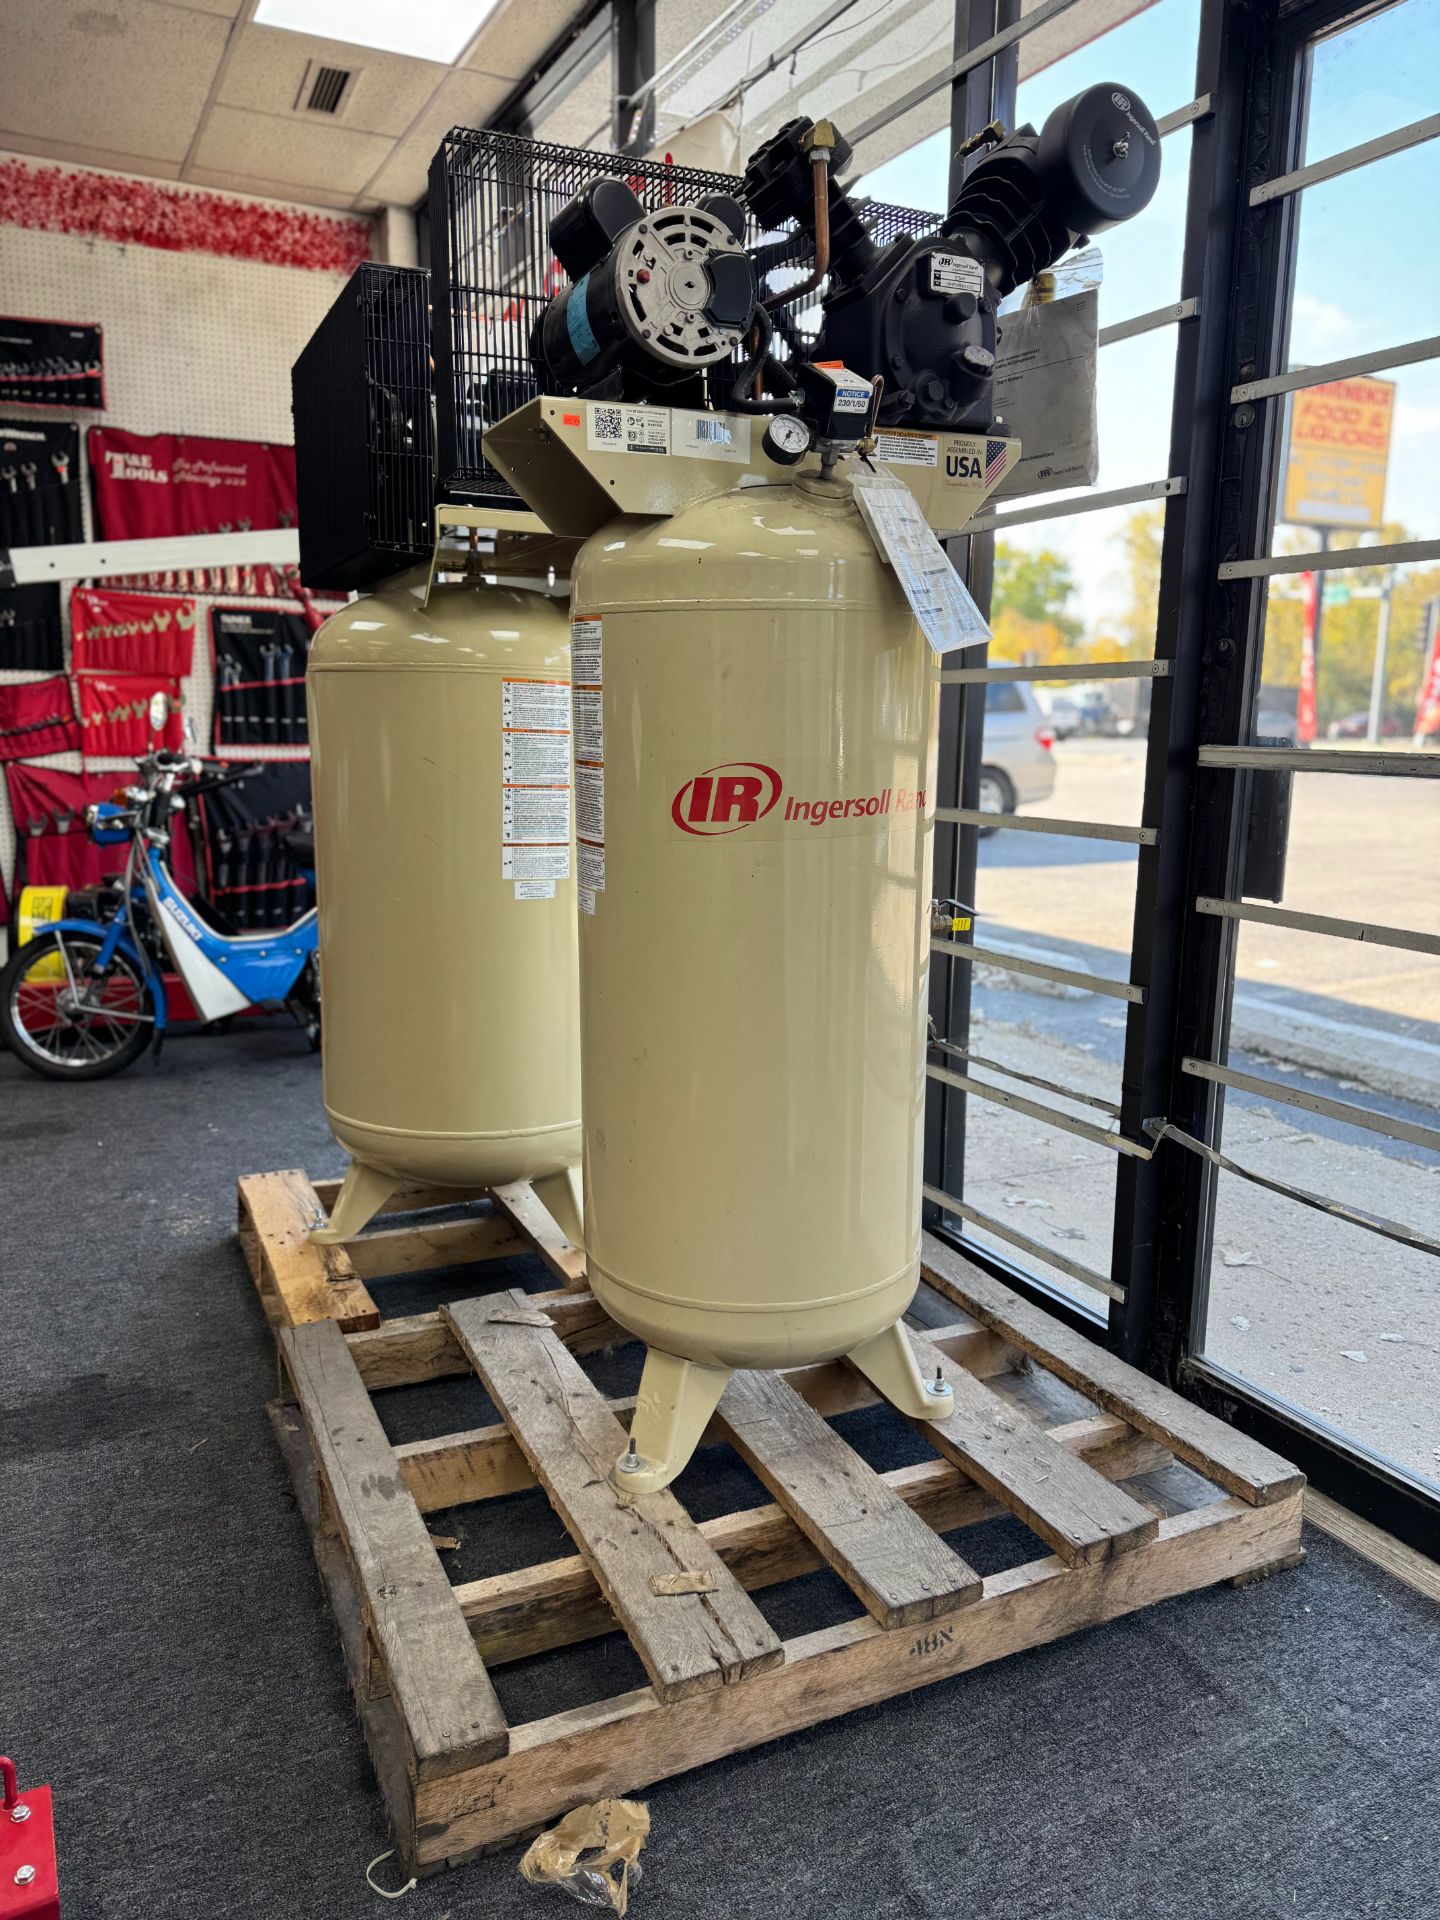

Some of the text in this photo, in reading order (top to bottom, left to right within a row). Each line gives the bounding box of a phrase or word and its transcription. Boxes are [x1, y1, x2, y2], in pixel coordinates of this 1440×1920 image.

[842, 390, 866, 398] NOTICE
[953, 439, 976, 447] PROUDLY
[946, 455, 983, 478] USA
[784, 788, 891, 826] Ingersoll
[162, 896, 203, 941] SUZUKI
